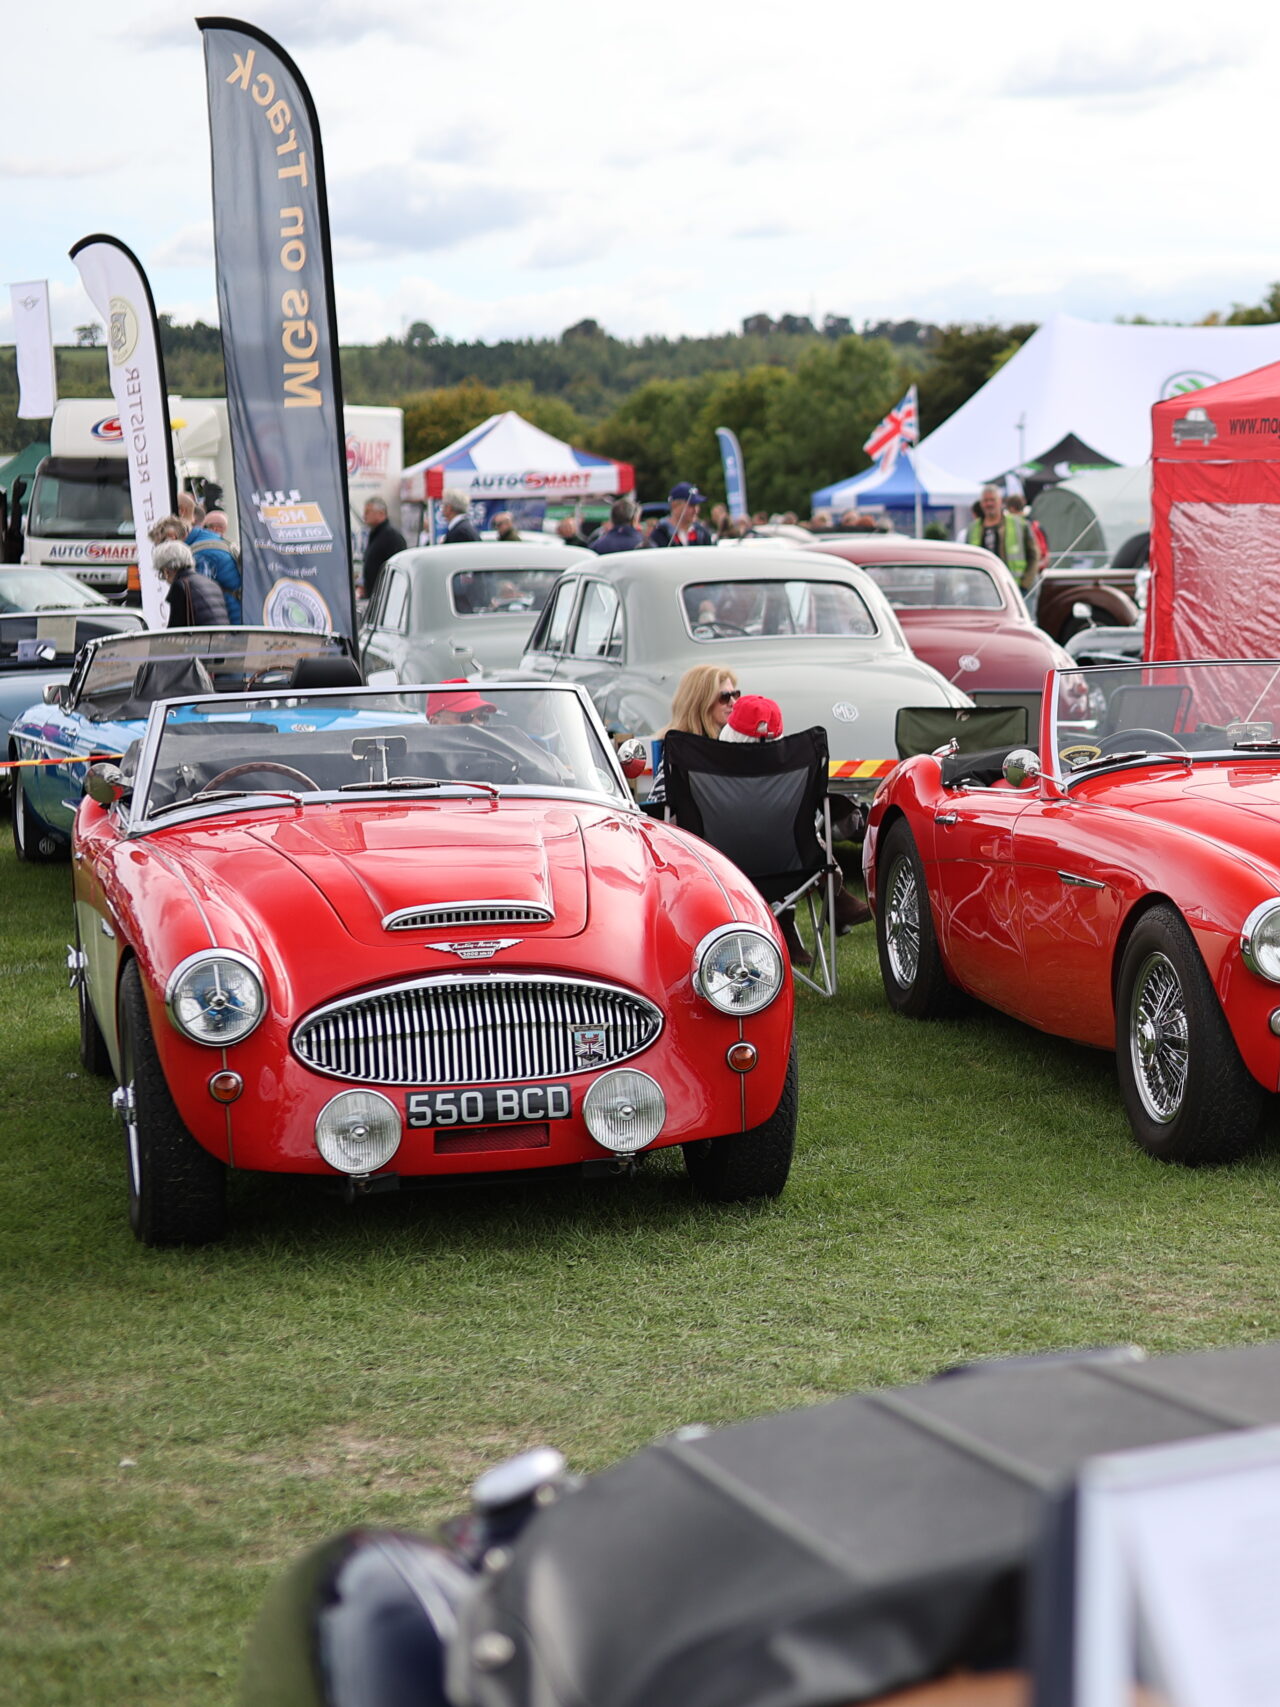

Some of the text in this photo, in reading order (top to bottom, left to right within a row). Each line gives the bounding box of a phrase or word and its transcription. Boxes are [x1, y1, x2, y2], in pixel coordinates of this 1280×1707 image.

[471, 471, 591, 489] AUTOSMART
[833, 703, 858, 721] MG
[409, 1086, 569, 1126] 550 BCD
